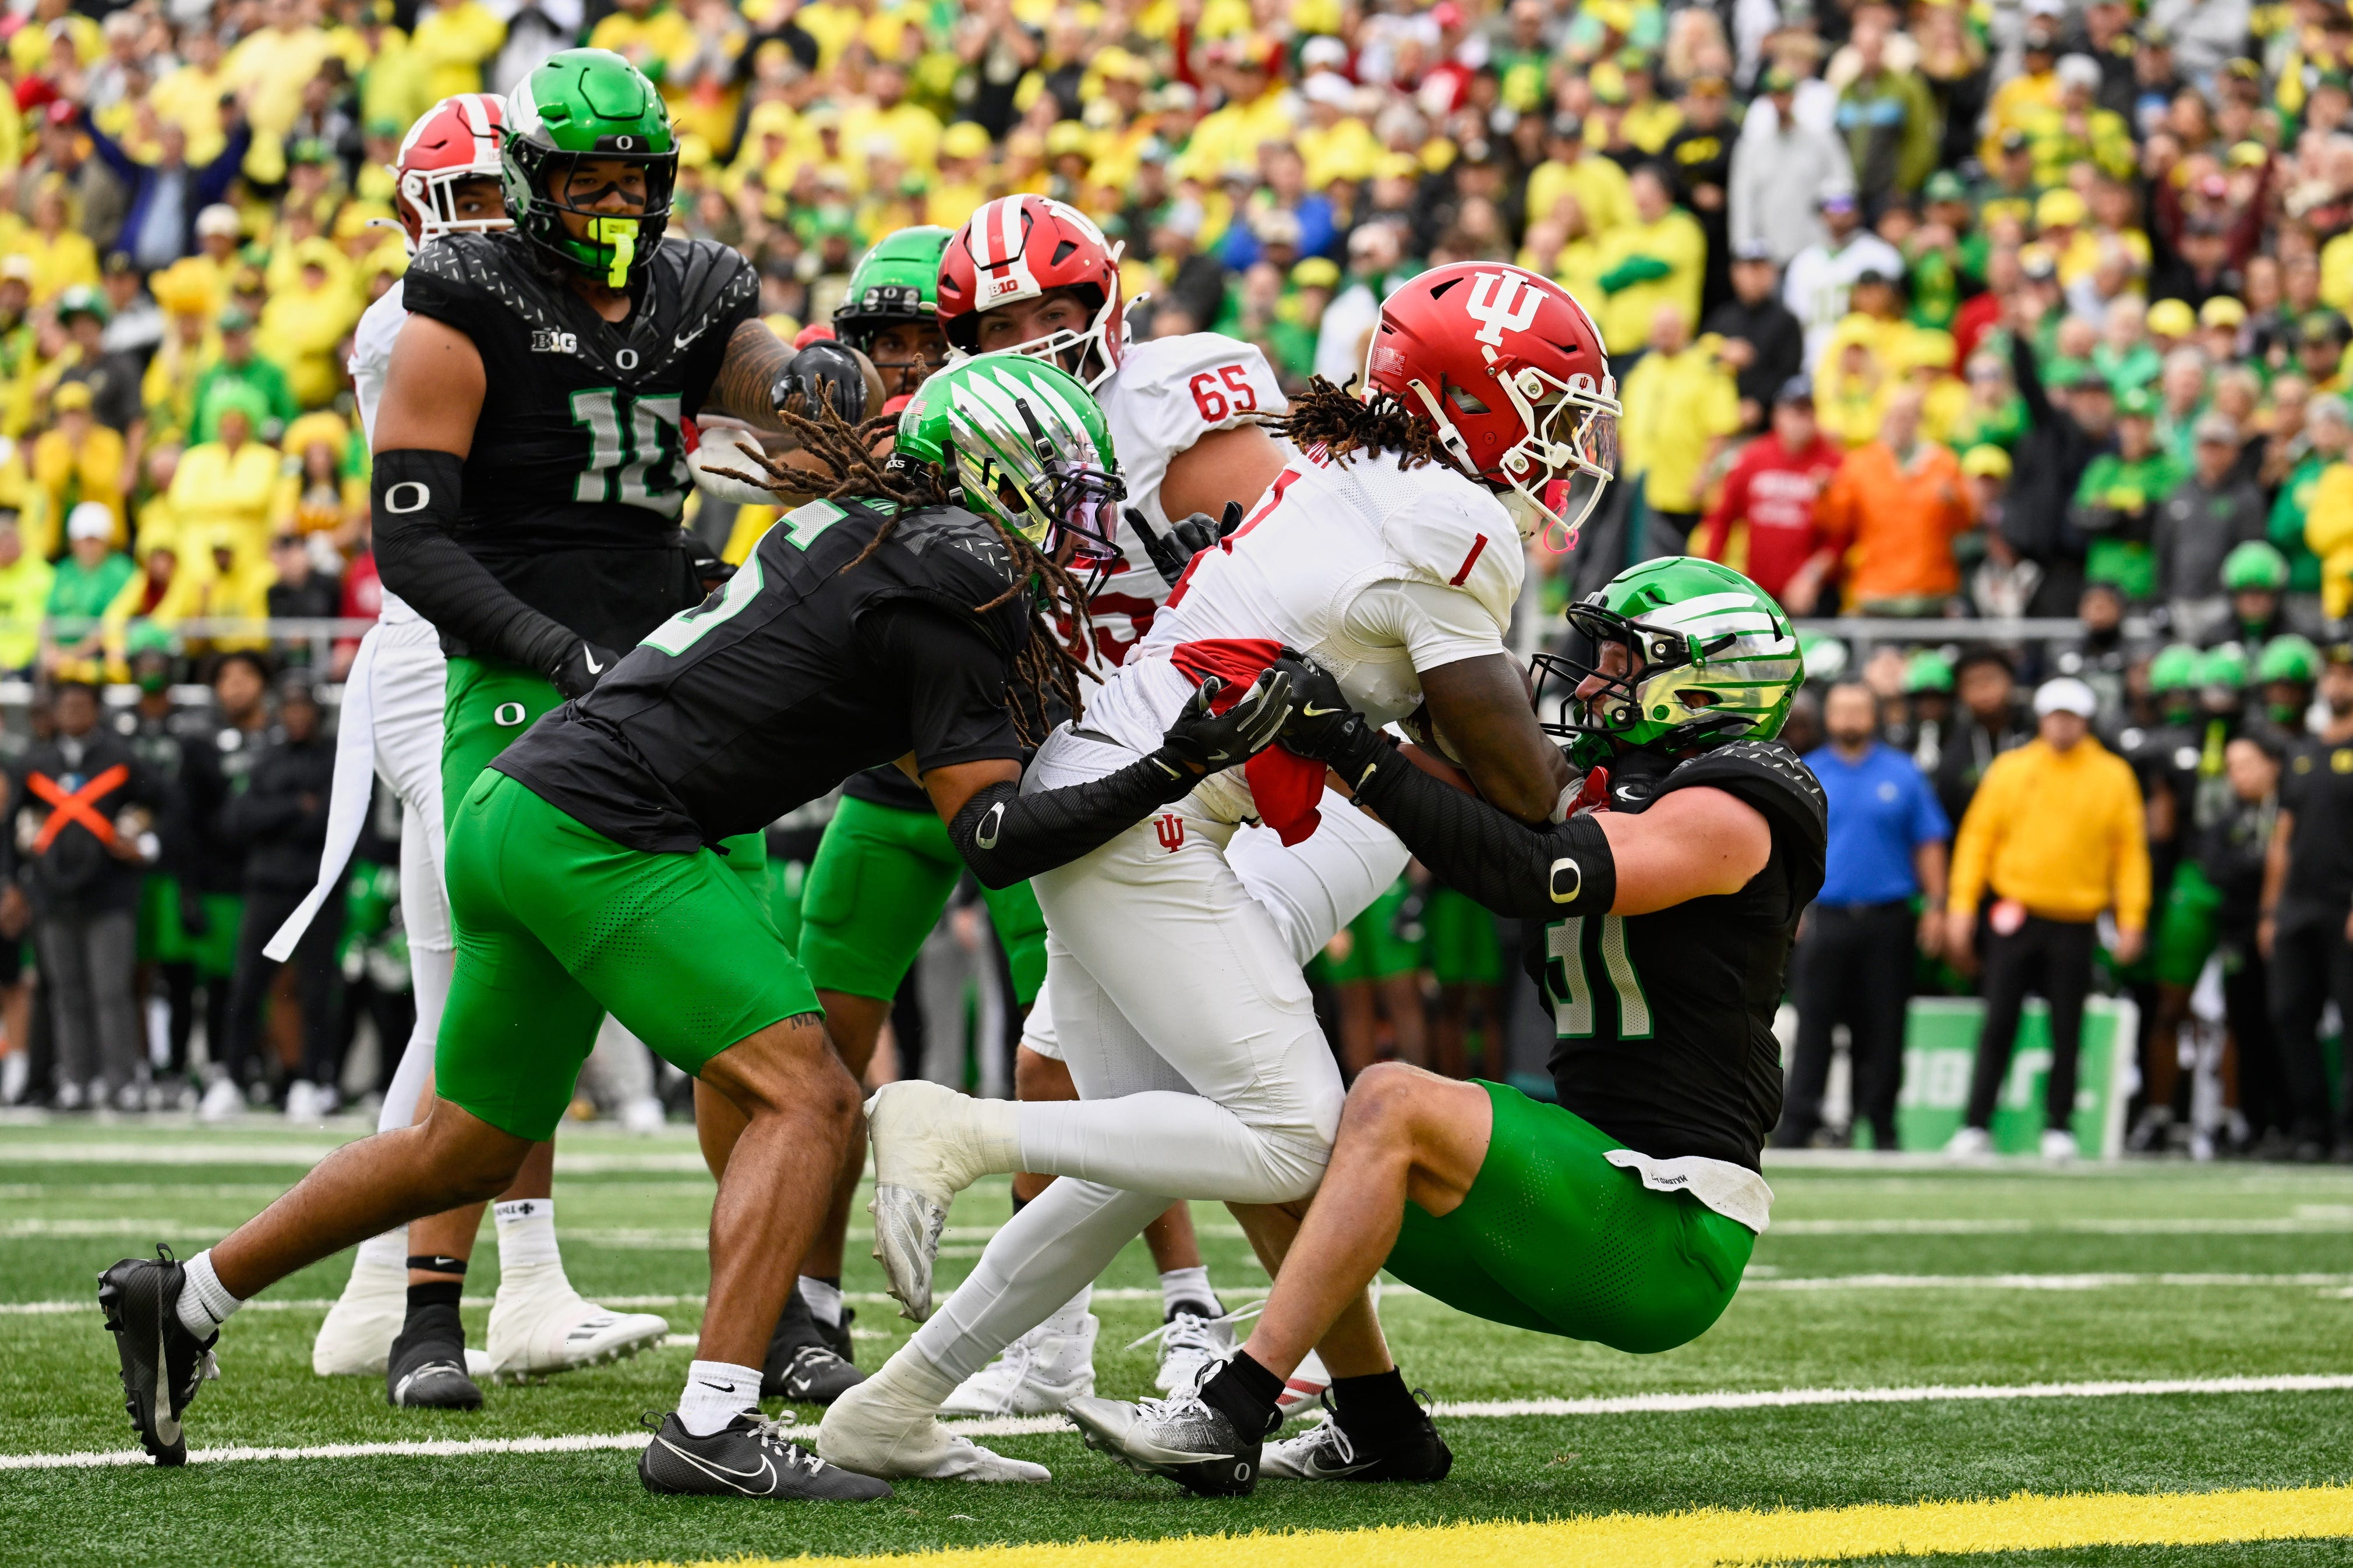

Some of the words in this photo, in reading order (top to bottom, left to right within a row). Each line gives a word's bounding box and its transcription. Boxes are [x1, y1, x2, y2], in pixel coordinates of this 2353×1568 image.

[616, 136, 633, 150] O
[616, 348, 639, 370] O
[1189, 364, 1257, 423] 65
[385, 482, 430, 514] O
[1448, 532, 1488, 586] 1
[493, 702, 525, 726] O
[1550, 857, 1581, 904] O
